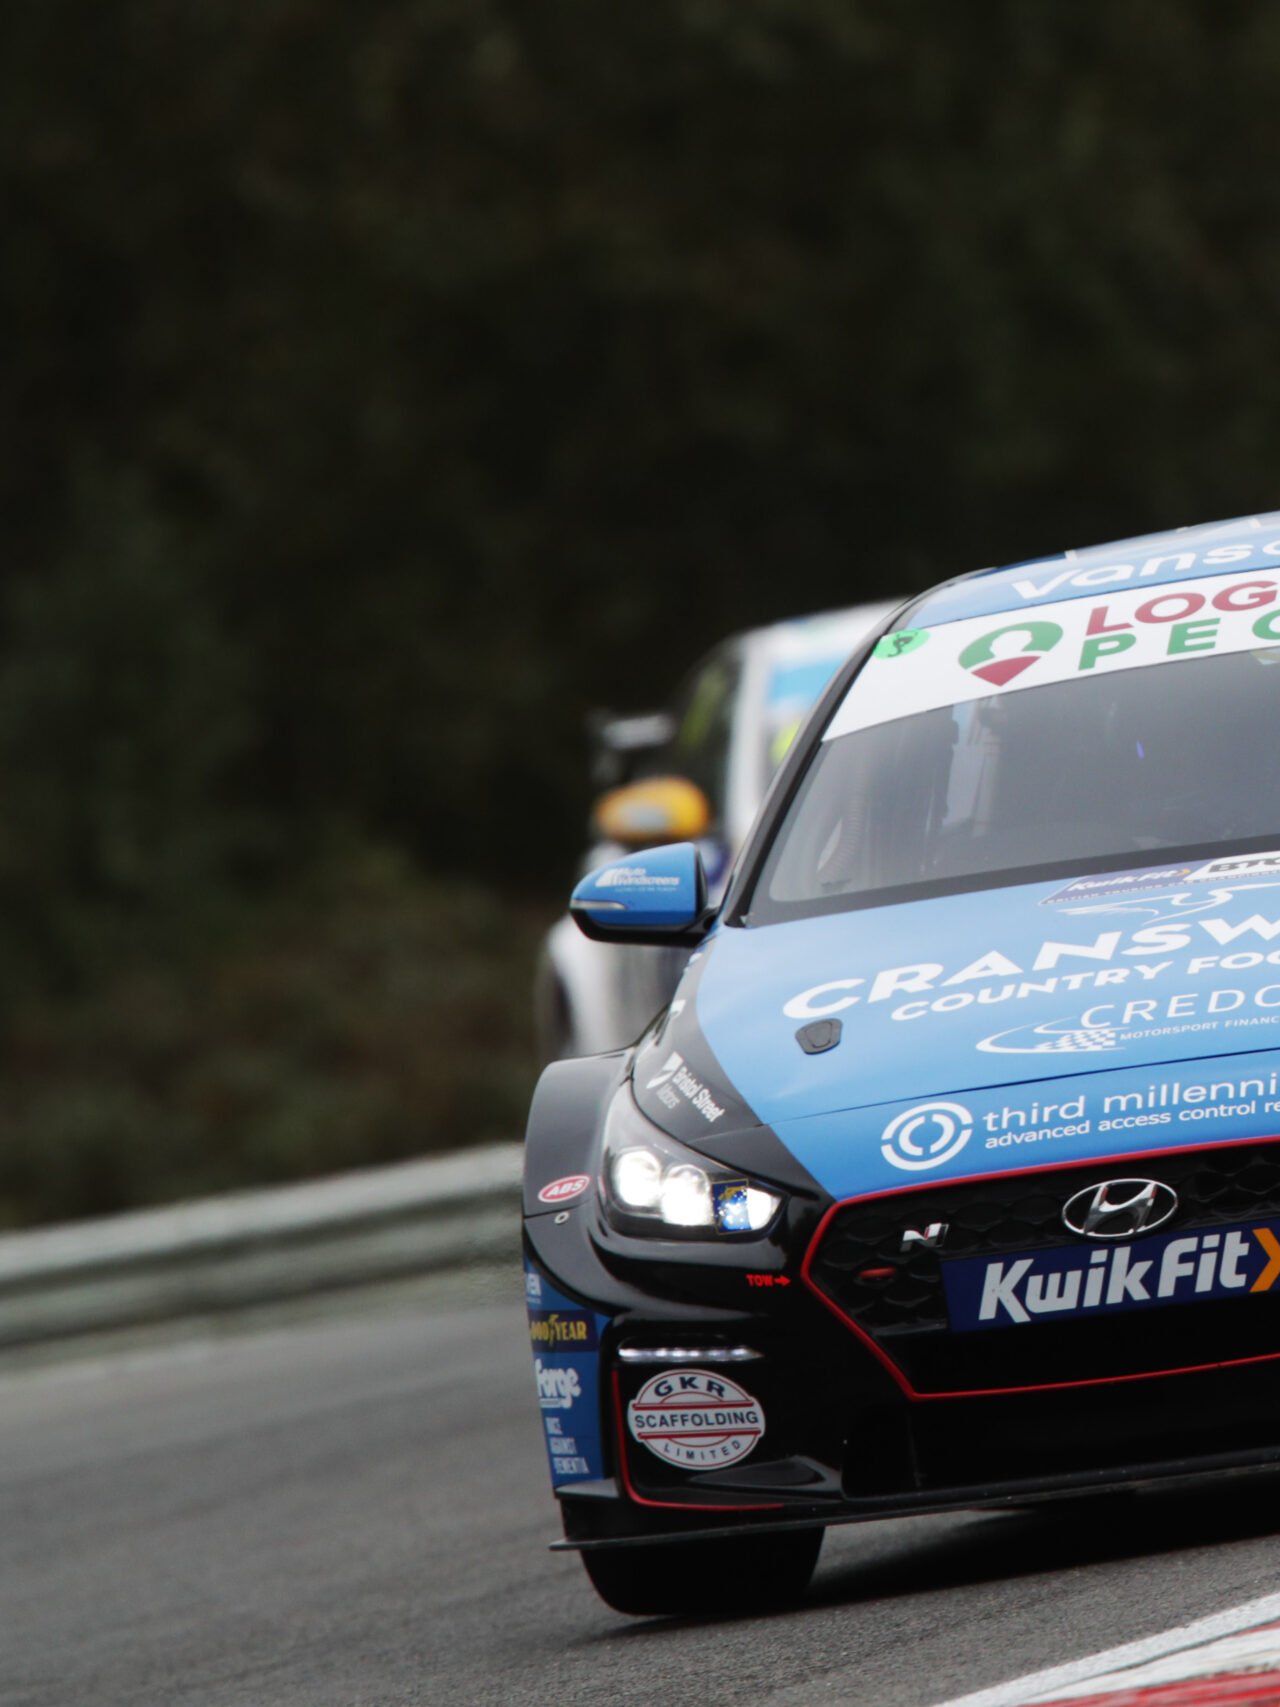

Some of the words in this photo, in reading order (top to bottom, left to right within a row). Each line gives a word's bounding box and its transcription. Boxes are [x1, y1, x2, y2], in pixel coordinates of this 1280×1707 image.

[890, 961, 1175, 1022] COUNTRY
[1119, 1021, 1219, 1042] MOTORSPORT
[983, 1095, 1084, 1131] third
[985, 1123, 1090, 1149] advanced
[1095, 1112, 1171, 1132] access
[1177, 1100, 1255, 1124] control
[746, 1274, 773, 1287] TOW
[654, 1376, 726, 1398] GKR
[634, 1410, 759, 1429] SCAFFOLDING
[664, 1440, 741, 1460] LIMITED
